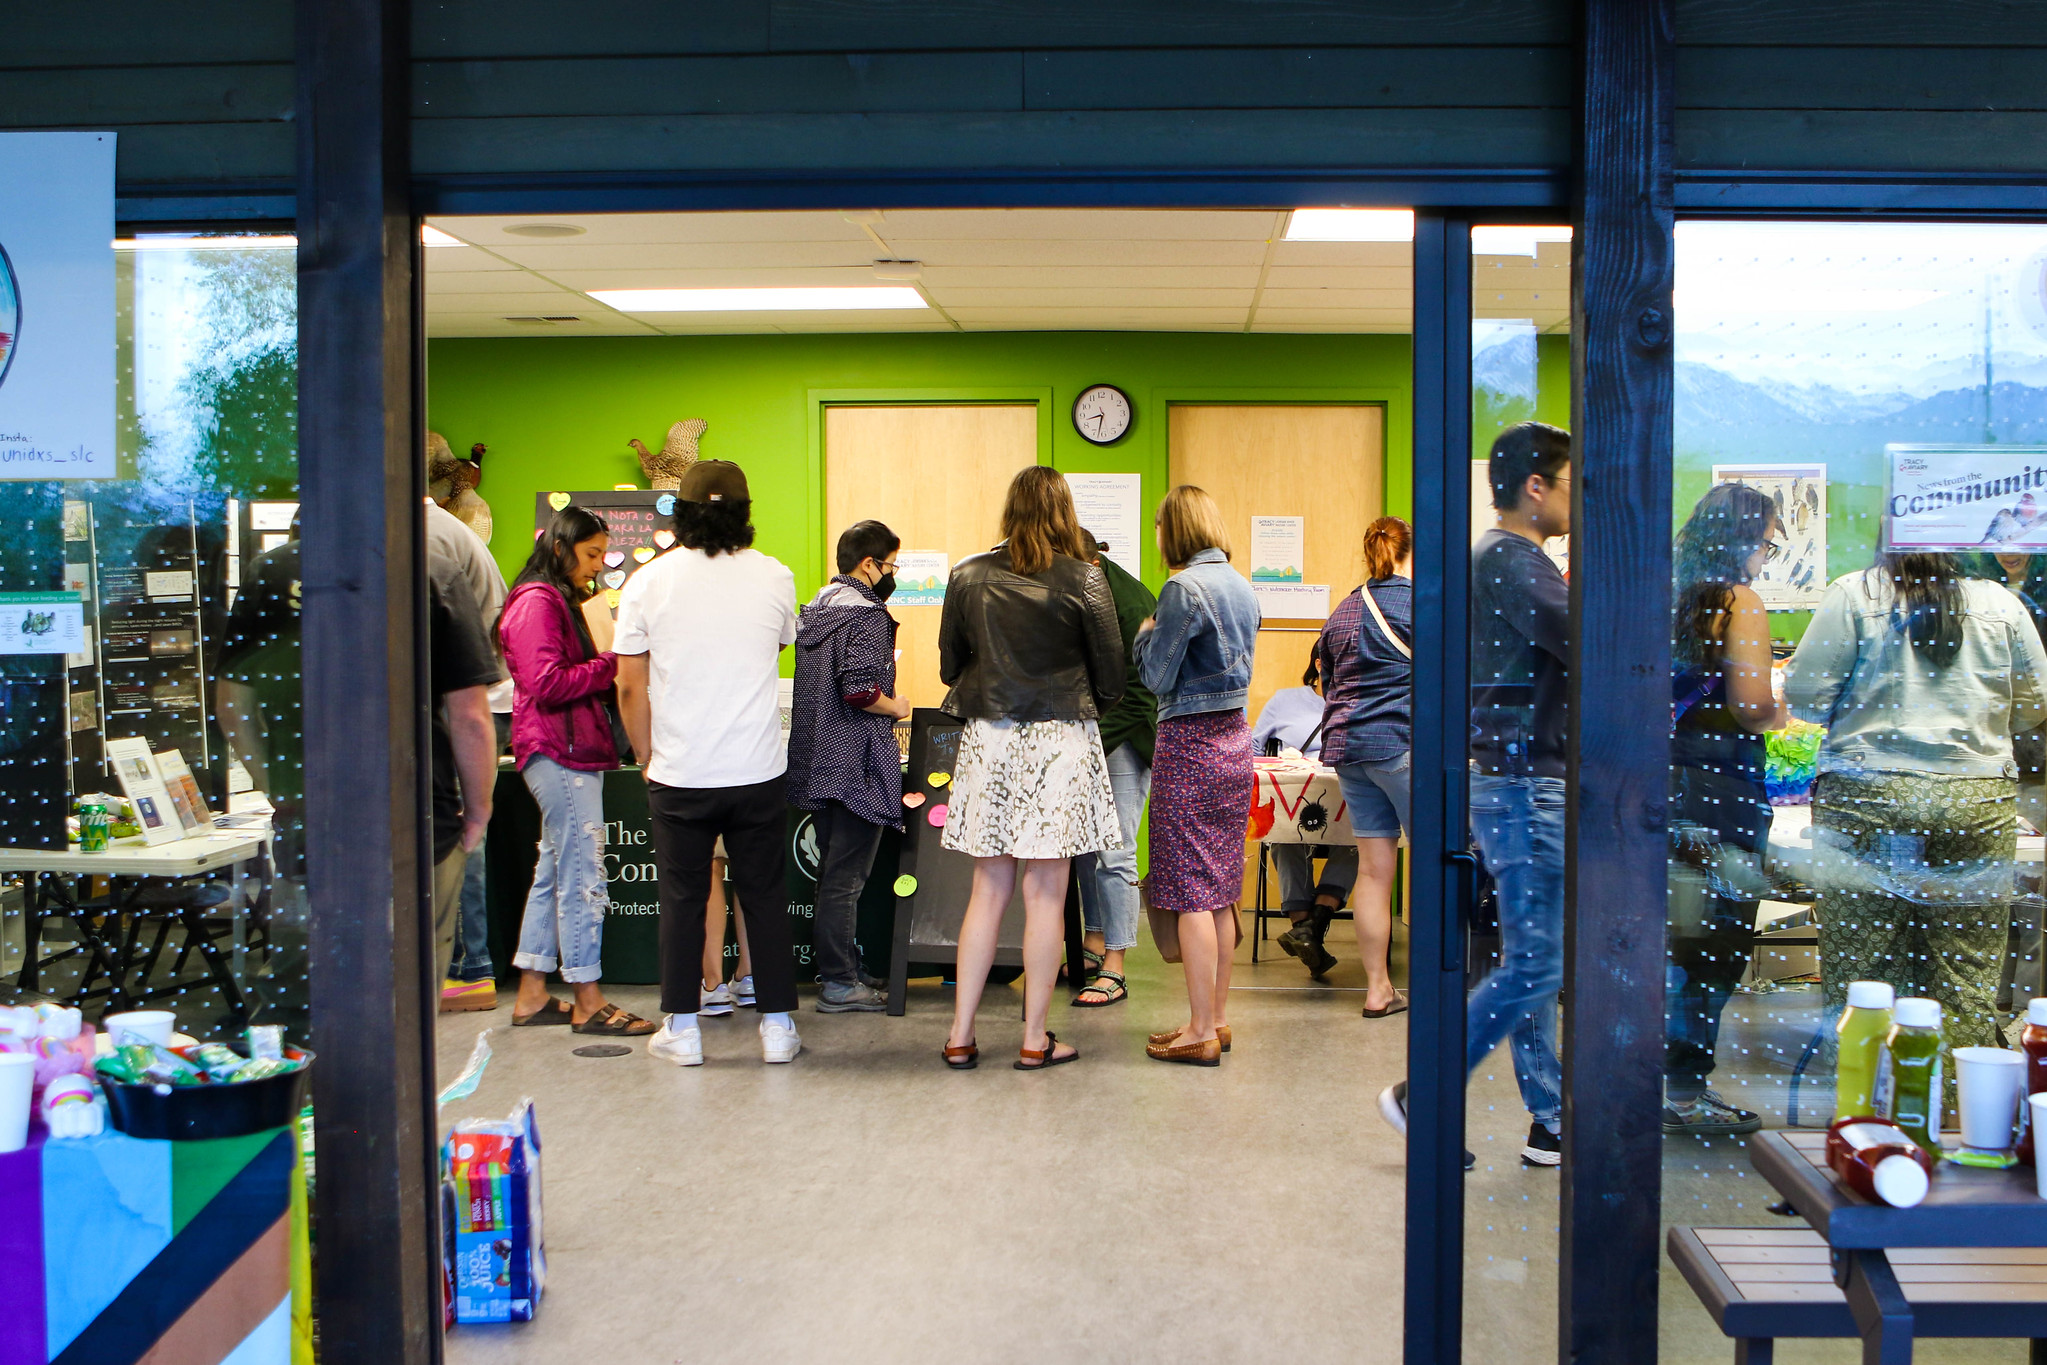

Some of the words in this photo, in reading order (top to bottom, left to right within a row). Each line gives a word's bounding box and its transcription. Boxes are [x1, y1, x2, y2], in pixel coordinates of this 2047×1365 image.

[1089, 394, 1096, 402] 11
[1097, 391, 1106, 399] 12
[1110, 393, 1114, 401] 1
[1116, 399, 1122, 407] 2
[0, 432, 33, 443] Insta:
[1917, 481, 1942, 492] News
[1943, 476, 1966, 487] from
[1967, 472, 1982, 481] the
[1890, 465, 2047, 518] Communit
[607, 510, 639, 521] NOTA
[640, 524, 653, 533] LA
[907, 596, 926, 604] Staff
[604, 820, 648, 846] The
[604, 853, 659, 883] Con
[610, 901, 661, 916] Protect
[483, 1200, 491, 1222] BERRY
[494, 1199, 502, 1221] APPLE
[478, 1243, 495, 1293] JUICE
